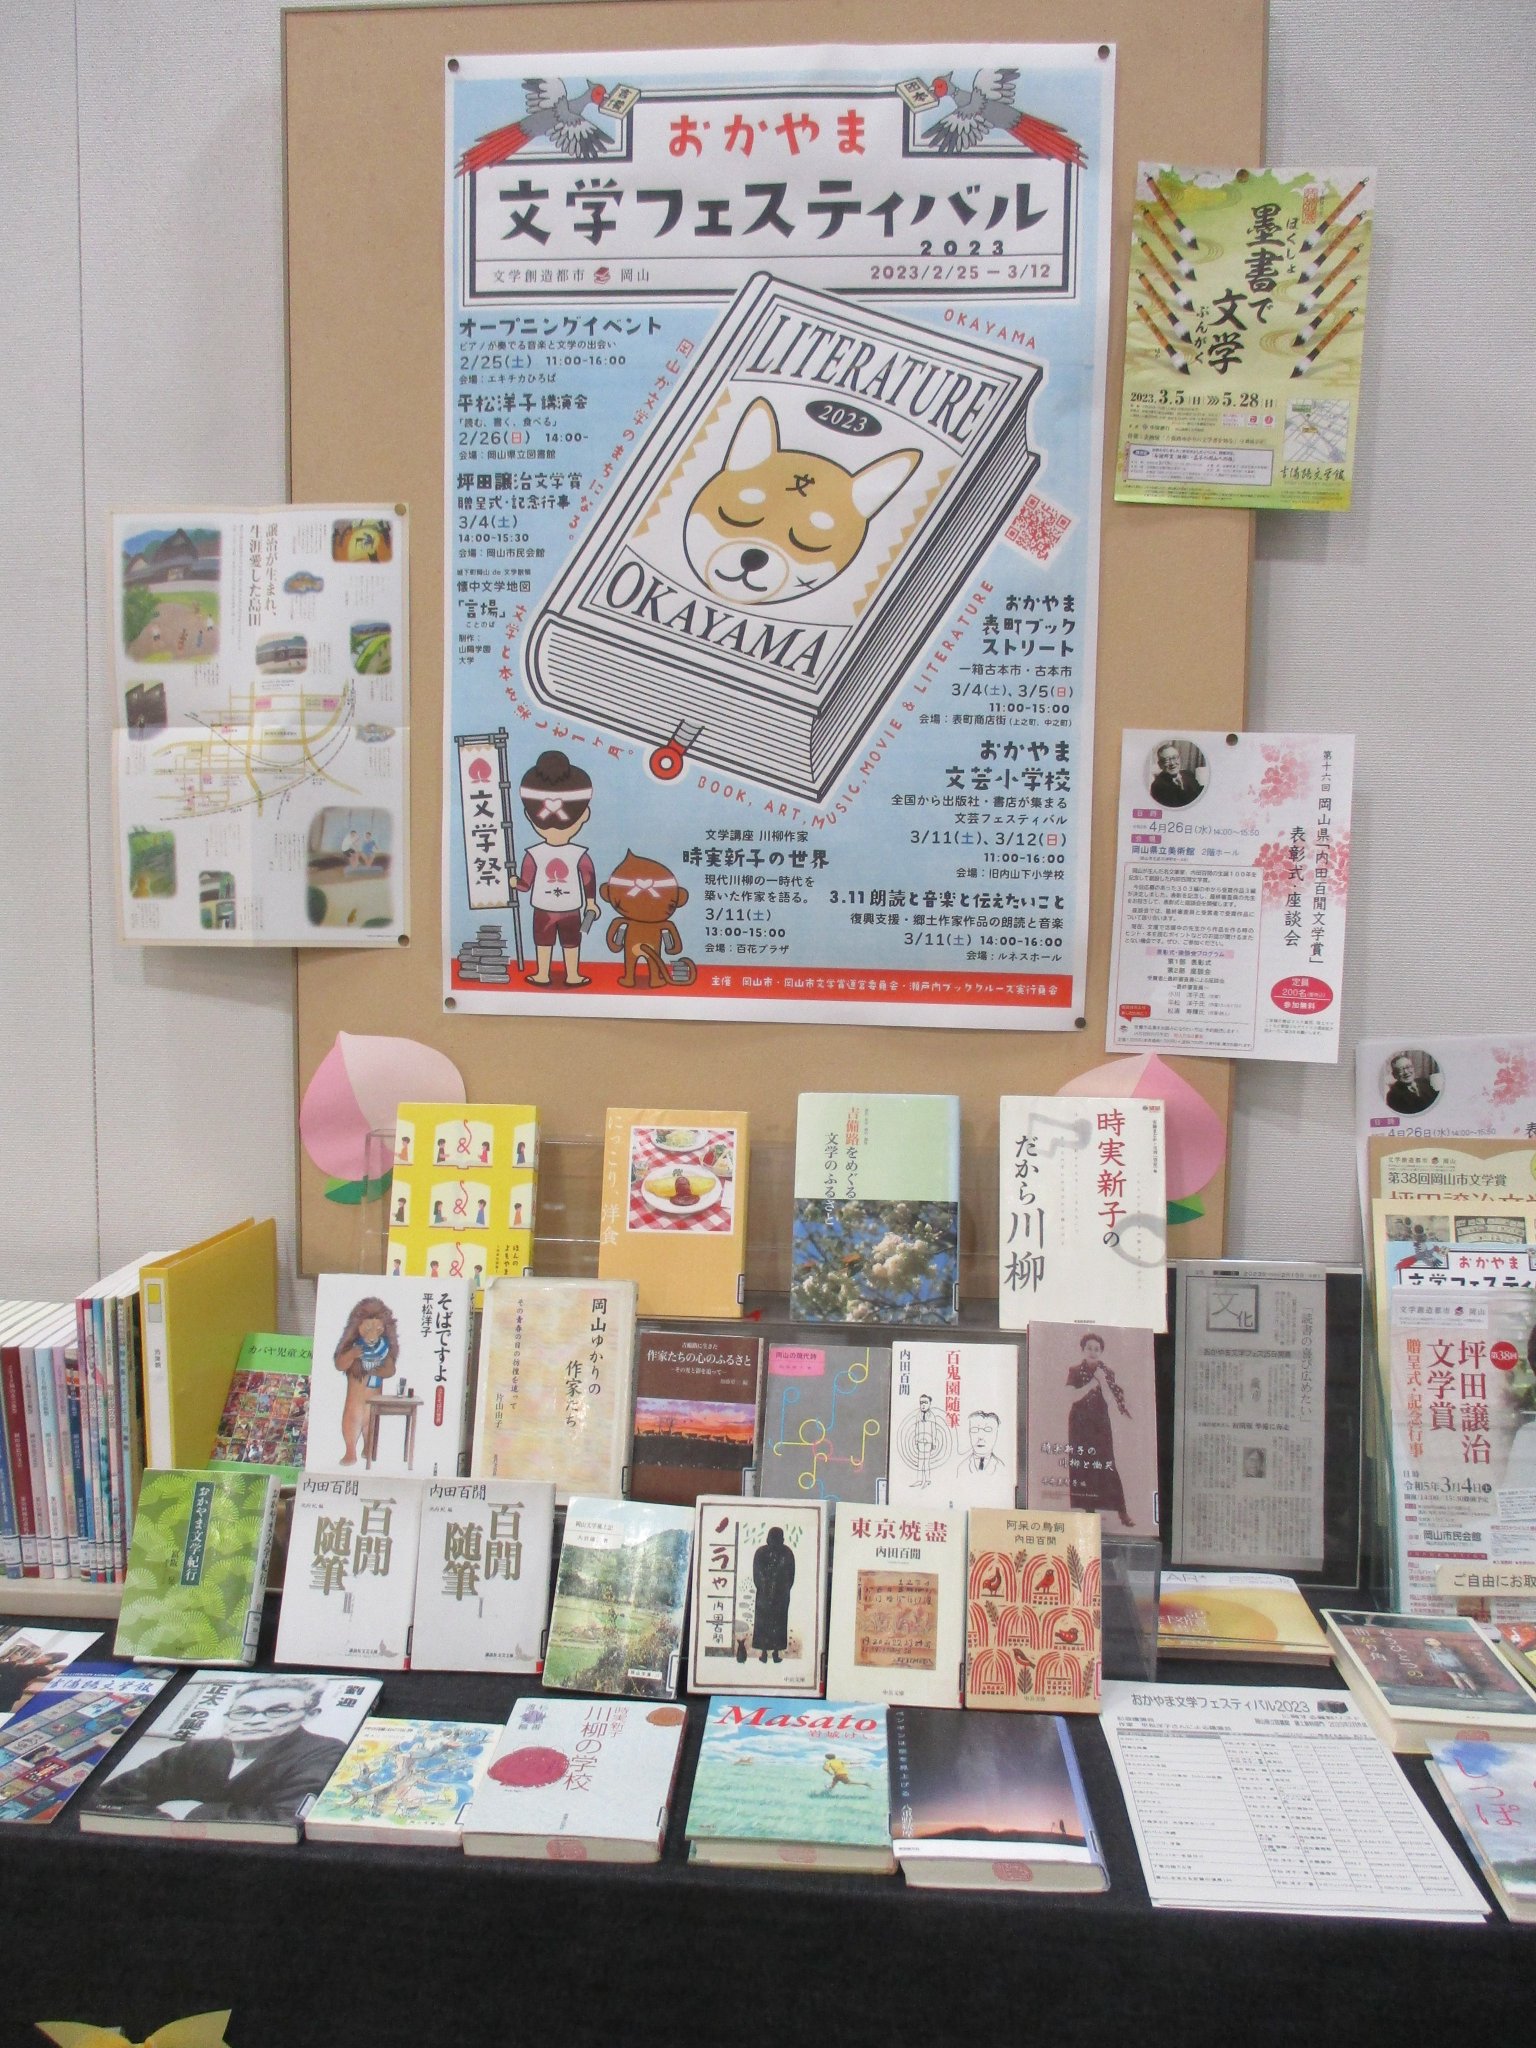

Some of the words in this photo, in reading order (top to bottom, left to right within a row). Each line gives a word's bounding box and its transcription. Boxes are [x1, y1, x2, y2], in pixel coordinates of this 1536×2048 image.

[669, 109, 868, 158] おかやま
[499, 179, 1048, 246] 文学フェスティバル
[920, 240, 1005, 257] 2023
[494, 267, 586, 284] 文学創造都市
[620, 266, 650, 284] 岡山
[460, 317, 661, 336] オープニングイベント
[944, 308, 1037, 350] OKAYAMA
[1208, 288, 1248, 375] 文学
[460, 340, 616, 350] ピアノが奏でる音楽と文学の出会い
[460, 356, 532, 370] 2/25(土)
[546, 356, 626, 366] 11:00-16:00
[746, 315, 999, 445] LITERATURE
[818, 404, 868, 433] 2023
[459, 431, 531, 446] 2/26(日)
[457, 472, 582, 490] 坪田譲治文学賞
[785, 473, 815, 497] 文
[457, 495, 570, 510] 贈呈式・記念行事
[458, 515, 518, 529] 3/4(土)
[458, 533, 529, 543] 14:00-15:30
[457, 581, 531, 592] 懐中文学地図
[458, 599, 506, 619] 「言場」
[1005, 594, 1075, 612] おかやま
[606, 561, 828, 678] OKAYAMA
[982, 614, 1076, 635] 表町ブック
[982, 638, 1074, 657] ストリート
[459, 657, 474, 665] 大学
[959, 663, 1072, 677] 一箱古本市・古本市
[698, 776, 752, 807] BOOK,
[860, 718, 902, 776] MOVIE
[902, 701, 916, 712] &
[913, 580, 994, 695] LITERATURE
[989, 702, 1070, 714] 11:00-15:00
[980, 739, 1070, 762] おかやま
[946, 765, 1070, 792] 文芸小学校
[1321, 750, 1333, 792] 第十六回
[891, 794, 1067, 810] 全国から出版社・書店が集まる
[954, 812, 1068, 825] 文芸フェスティバル
[470, 790, 503, 887] 文学祭
[706, 830, 754, 841] 文学講座
[760, 830, 809, 842] 川柳作家
[683, 848, 830, 870] 時実新子の世界
[984, 853, 1065, 864] 11:00-16:00
[1132, 845, 1195, 856] 岡山県立美術館
[705, 874, 814, 888] 現代川柳の一時代を
[1284, 826, 1307, 947] 表彰式・座談会
[705, 890, 809, 904] 築いた作家を語る。
[705, 907, 772, 922] 3/11(土)
[850, 913, 1064, 930] 復興支援・郷土作家作品の朗読と音楽
[705, 926, 786, 938] 13:00-15:00
[904, 932, 972, 947] 3/11(土)
[980, 936, 1063, 947] 14:00-16:00
[711, 976, 731, 987] 主催
[824, 1133, 839, 1225] 文学のふるさと
[1097, 1109, 1127, 1248] 時実新子の
[1388, 1172, 1507, 1186] 第38回岡山市文学賞
[1004, 1135, 1045, 1293] だから川柳
[1459, 1256, 1519, 1269] おかやま
[421, 1293, 434, 1338] 平松洋子
[434, 1293, 453, 1382] そばですよ
[589, 1298, 608, 1396] 岡山ゆかりの
[647, 1350, 751, 1367] 作家たちの心のふるさと
[775, 1351, 817, 1361] 岡山の現代詩
[565, 1359, 583, 1428] 作家たち
[945, 1350, 961, 1429] 百鬼園随筆
[1427, 1339, 1456, 1431] 文学賞
[185, 1487, 210, 1581] おかやま文学紀行
[850, 1518, 948, 1543] 東京焼盡
[1424, 1530, 1482, 1541] 岡山市民会館
[309, 1516, 354, 1597] 随筆
[441, 1521, 483, 1601] 随筆
[711, 1517, 729, 1590] ノラや
[1132, 1694, 1310, 1713] おかやま文学フェスティバル2023
[713, 1705, 878, 1732] Masato
[564, 1706, 613, 1792] 川柳の学校
